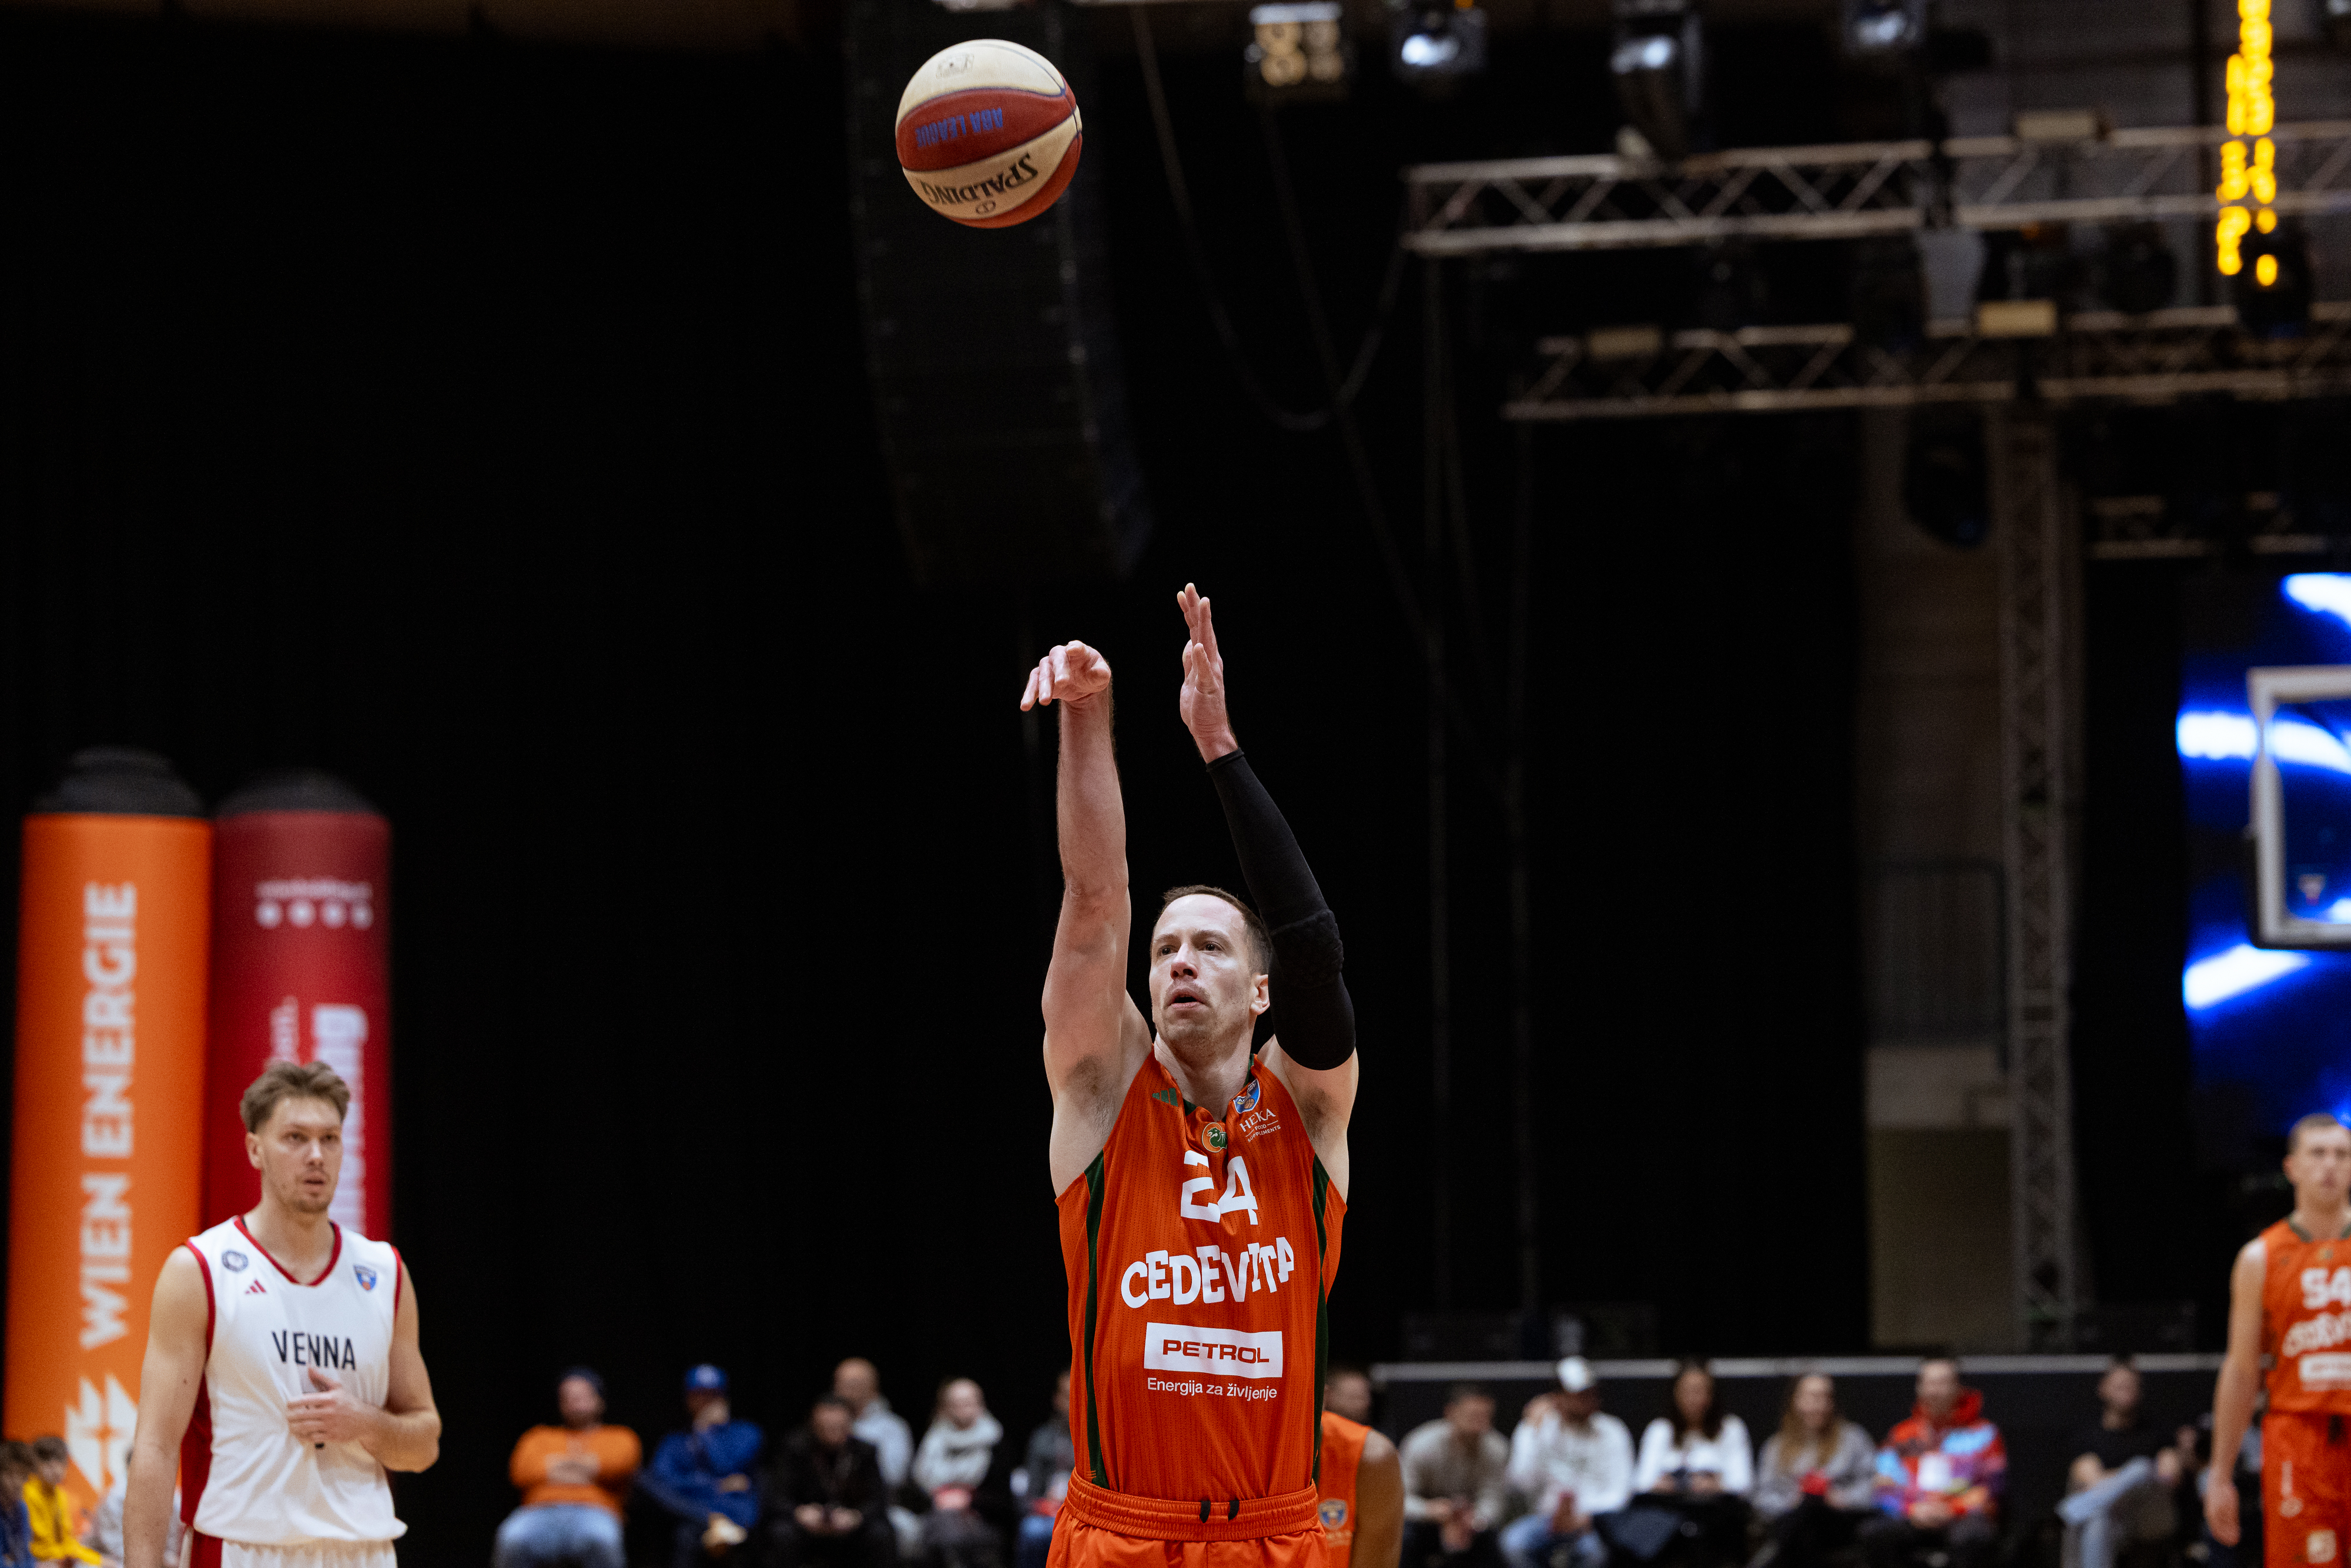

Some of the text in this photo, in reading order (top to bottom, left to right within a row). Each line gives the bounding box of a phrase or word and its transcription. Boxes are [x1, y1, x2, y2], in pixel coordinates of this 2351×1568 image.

[969, 108, 1003, 133] ABA
[919, 153, 1038, 205] SPALDING
[81, 882, 136, 1350] WIEN ENERGIE
[1240, 1108, 1276, 1132] HEKA
[1248, 1125, 1281, 1143] SUPPLEMENTS
[1181, 1150, 1258, 1225] 24
[1121, 1237, 1294, 1308] CEDEVITA
[1163, 1339, 1270, 1364] PETROL
[1147, 1377, 1277, 1402] Energija za življenje
